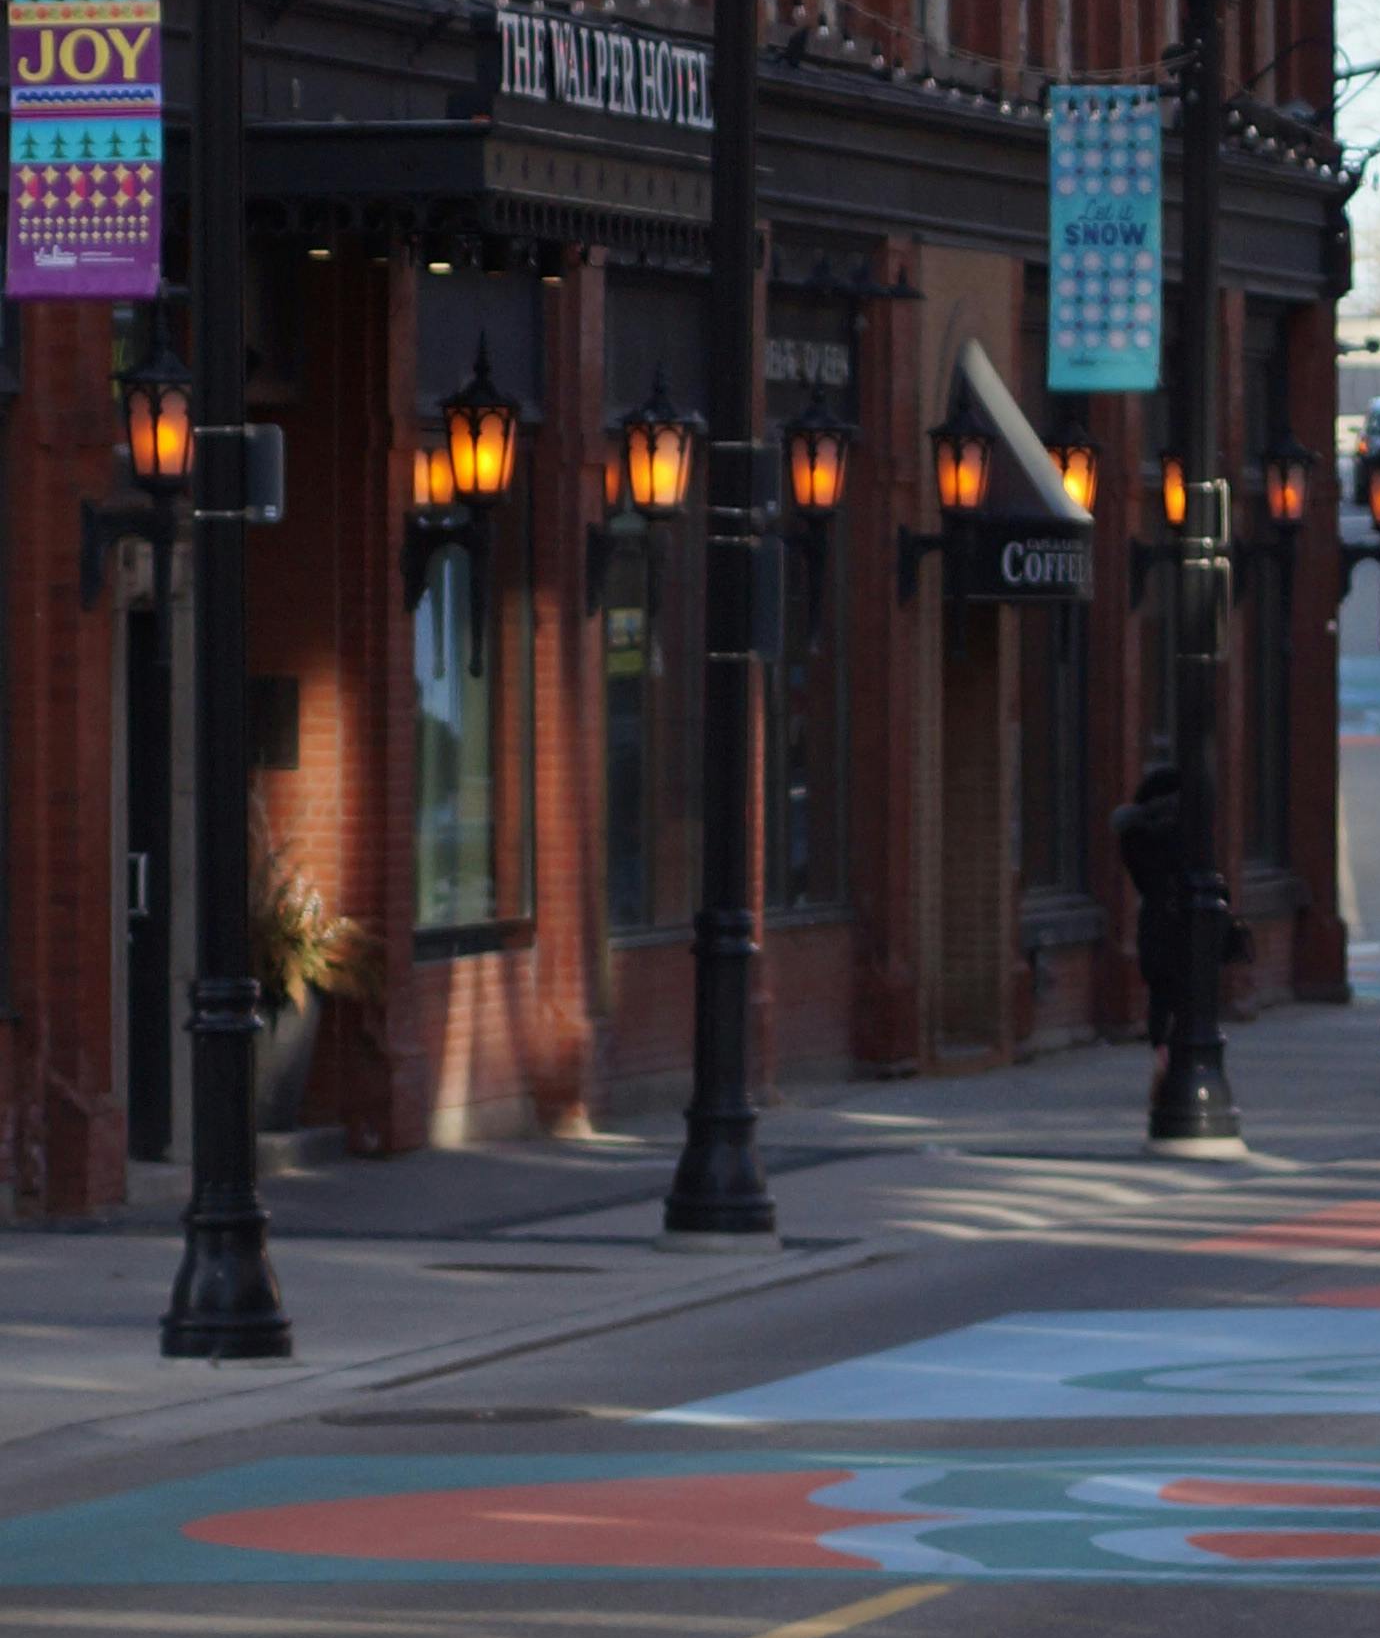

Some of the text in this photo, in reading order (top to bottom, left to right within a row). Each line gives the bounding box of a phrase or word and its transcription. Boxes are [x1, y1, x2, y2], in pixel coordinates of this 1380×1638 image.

[18, 27, 151, 81] JOY
[499, 12, 714, 130] THE WALPER HOTEL
[1064, 222, 1147, 246] SNOW
